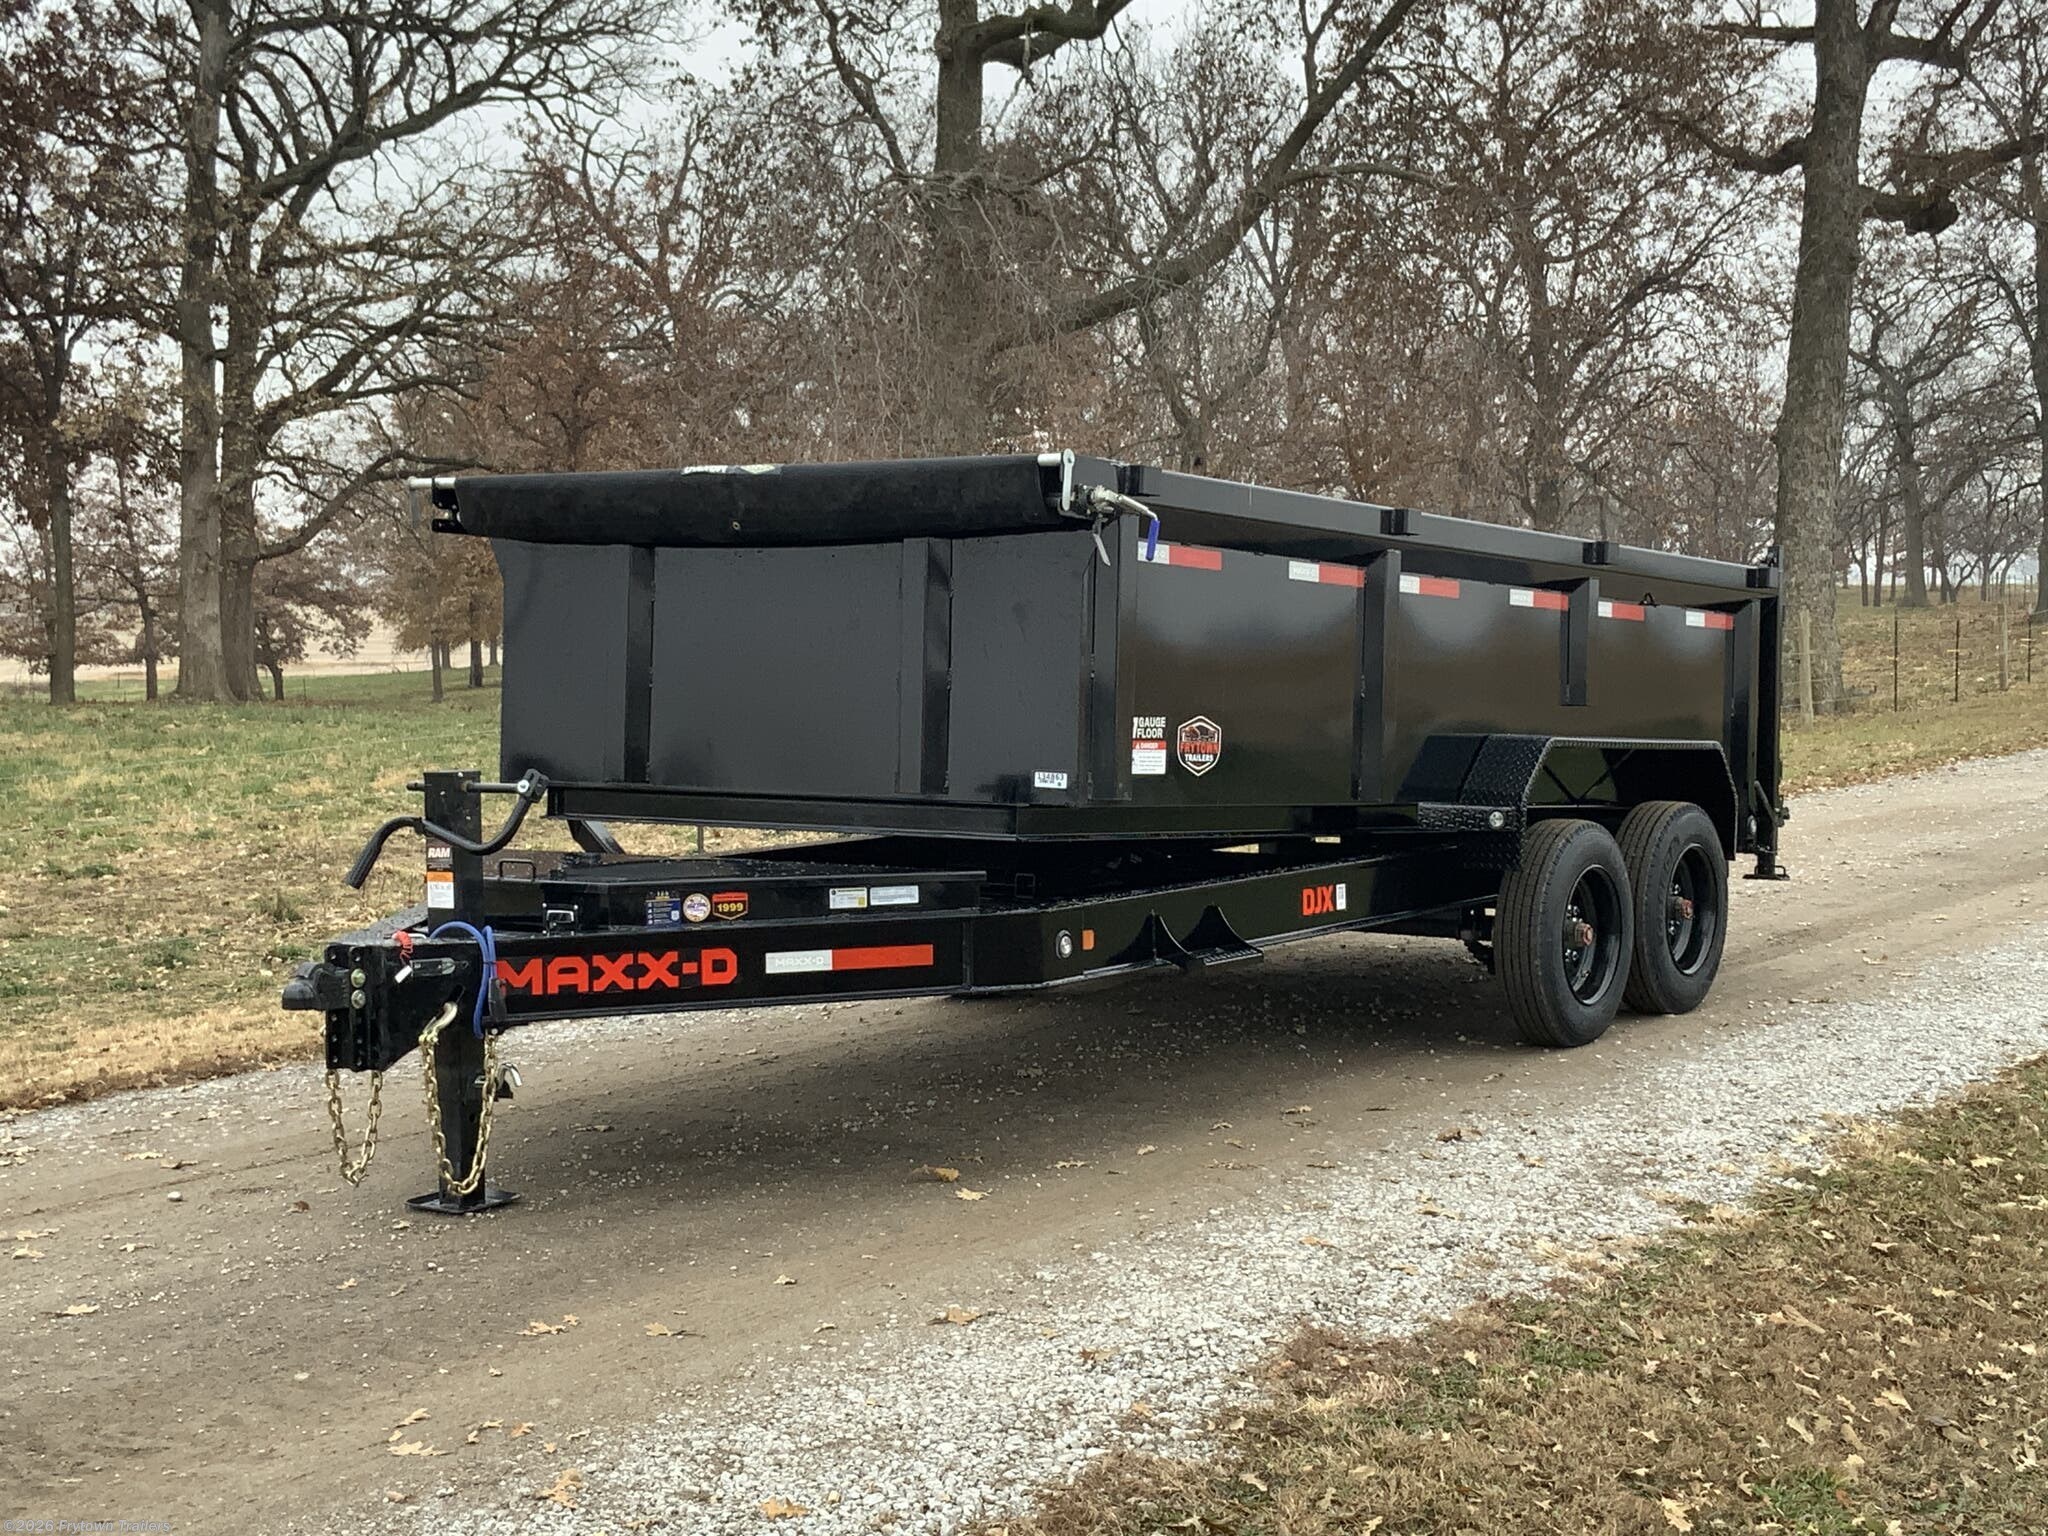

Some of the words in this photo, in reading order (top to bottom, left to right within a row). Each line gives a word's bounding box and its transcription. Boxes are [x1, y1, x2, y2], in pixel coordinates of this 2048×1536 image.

[1138, 717, 1166, 727] GAUGE
[1137, 728, 1163, 738] FLOOR
[1181, 742, 1219, 753] FRYTOWN
[1184, 754, 1214, 762] TRAILERS
[428, 847, 450, 858] RAM
[1302, 885, 1334, 915] DJX
[717, 902, 744, 912] 1999
[497, 948, 738, 995] MAXX-D
